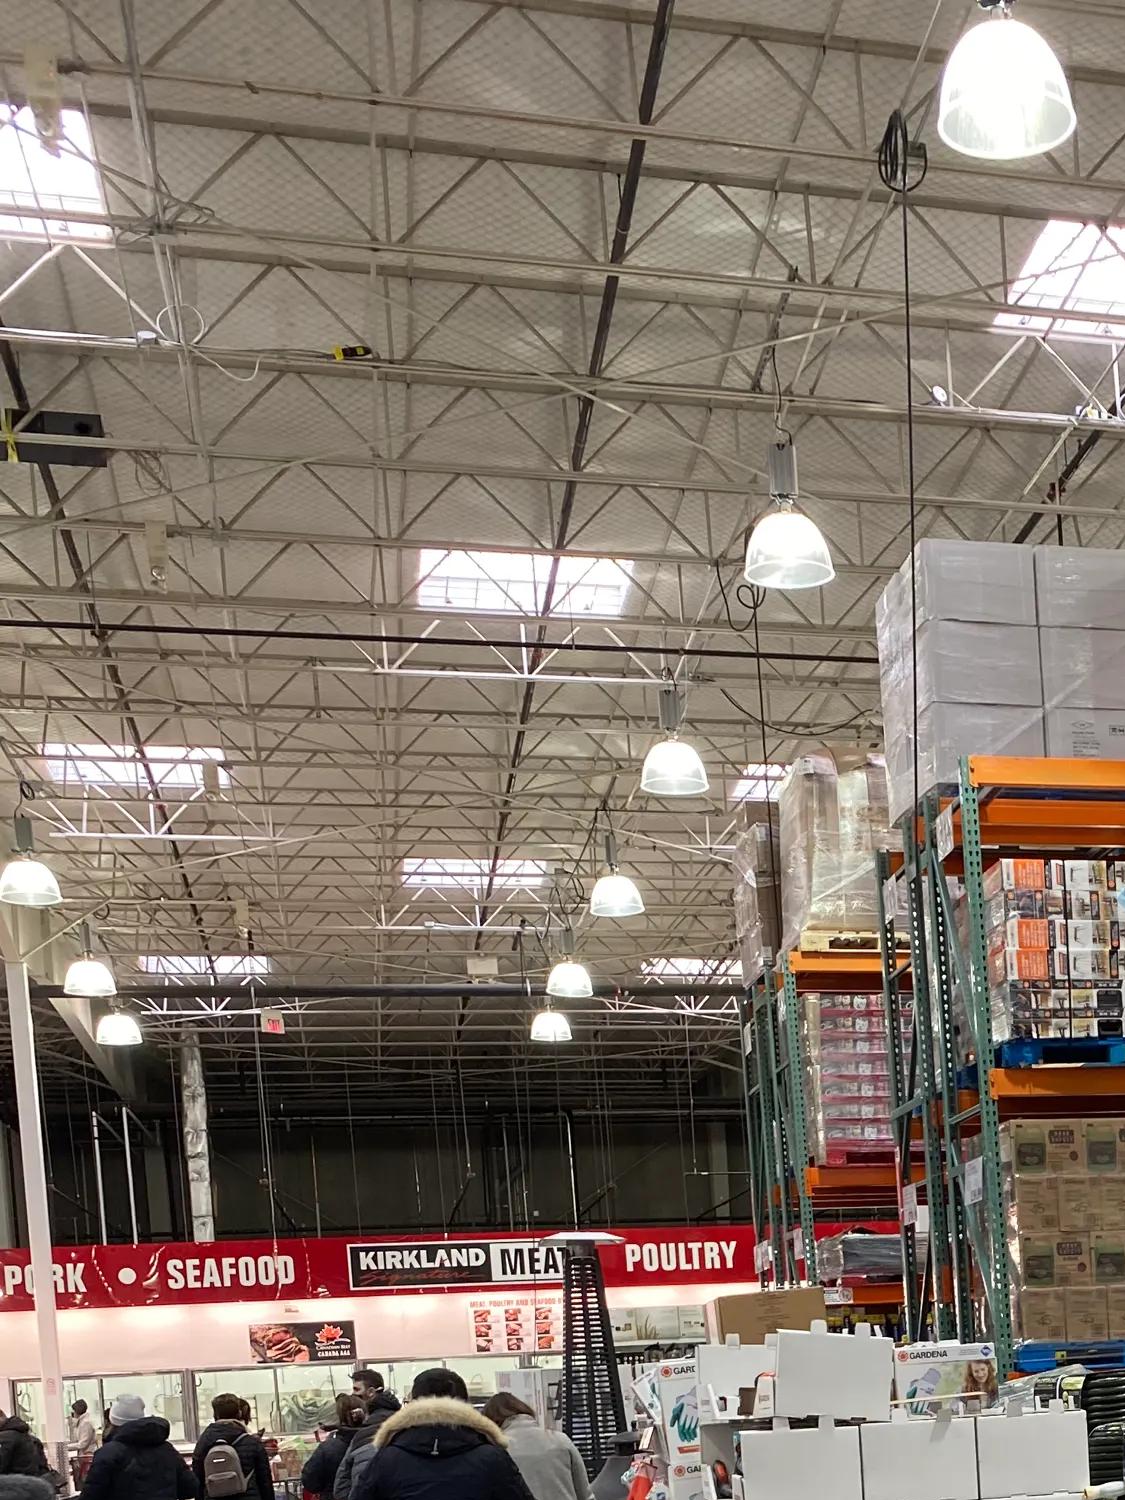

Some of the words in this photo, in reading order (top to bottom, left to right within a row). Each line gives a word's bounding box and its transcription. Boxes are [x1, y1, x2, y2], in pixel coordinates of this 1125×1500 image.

[166, 1255, 295, 1290] SEAFOOD
[359, 1247, 487, 1271] KIRKLAND
[626, 1240, 737, 1273] POULTRY
[909, 1349, 949, 1361] GARDENA
